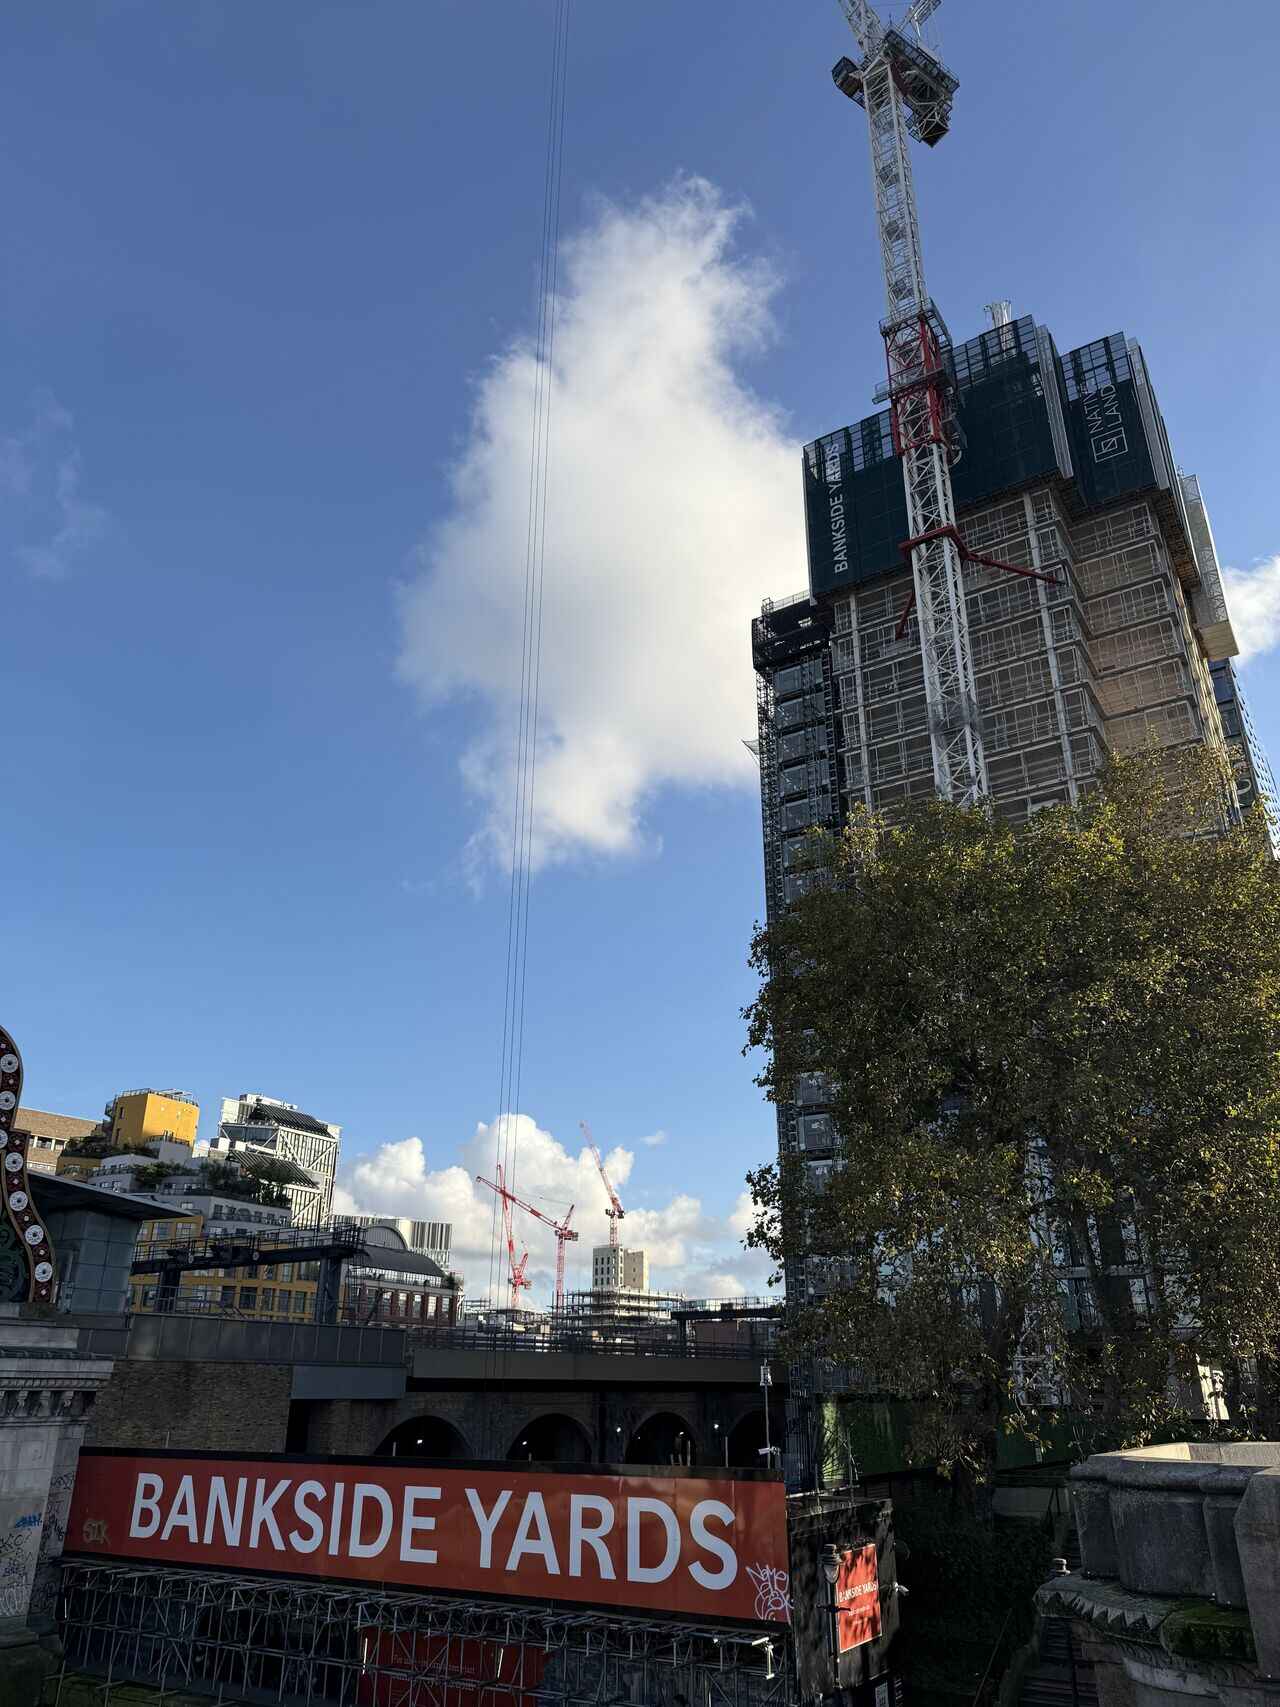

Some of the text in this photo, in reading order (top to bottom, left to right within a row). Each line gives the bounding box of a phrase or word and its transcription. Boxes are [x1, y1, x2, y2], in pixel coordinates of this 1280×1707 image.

[1100, 384, 1122, 428] LAND
[824, 442, 849, 574] BANKSIDE YARDS
[130, 1473, 441, 1563] BANKSIDE
[465, 1489, 738, 1590] YARDS
